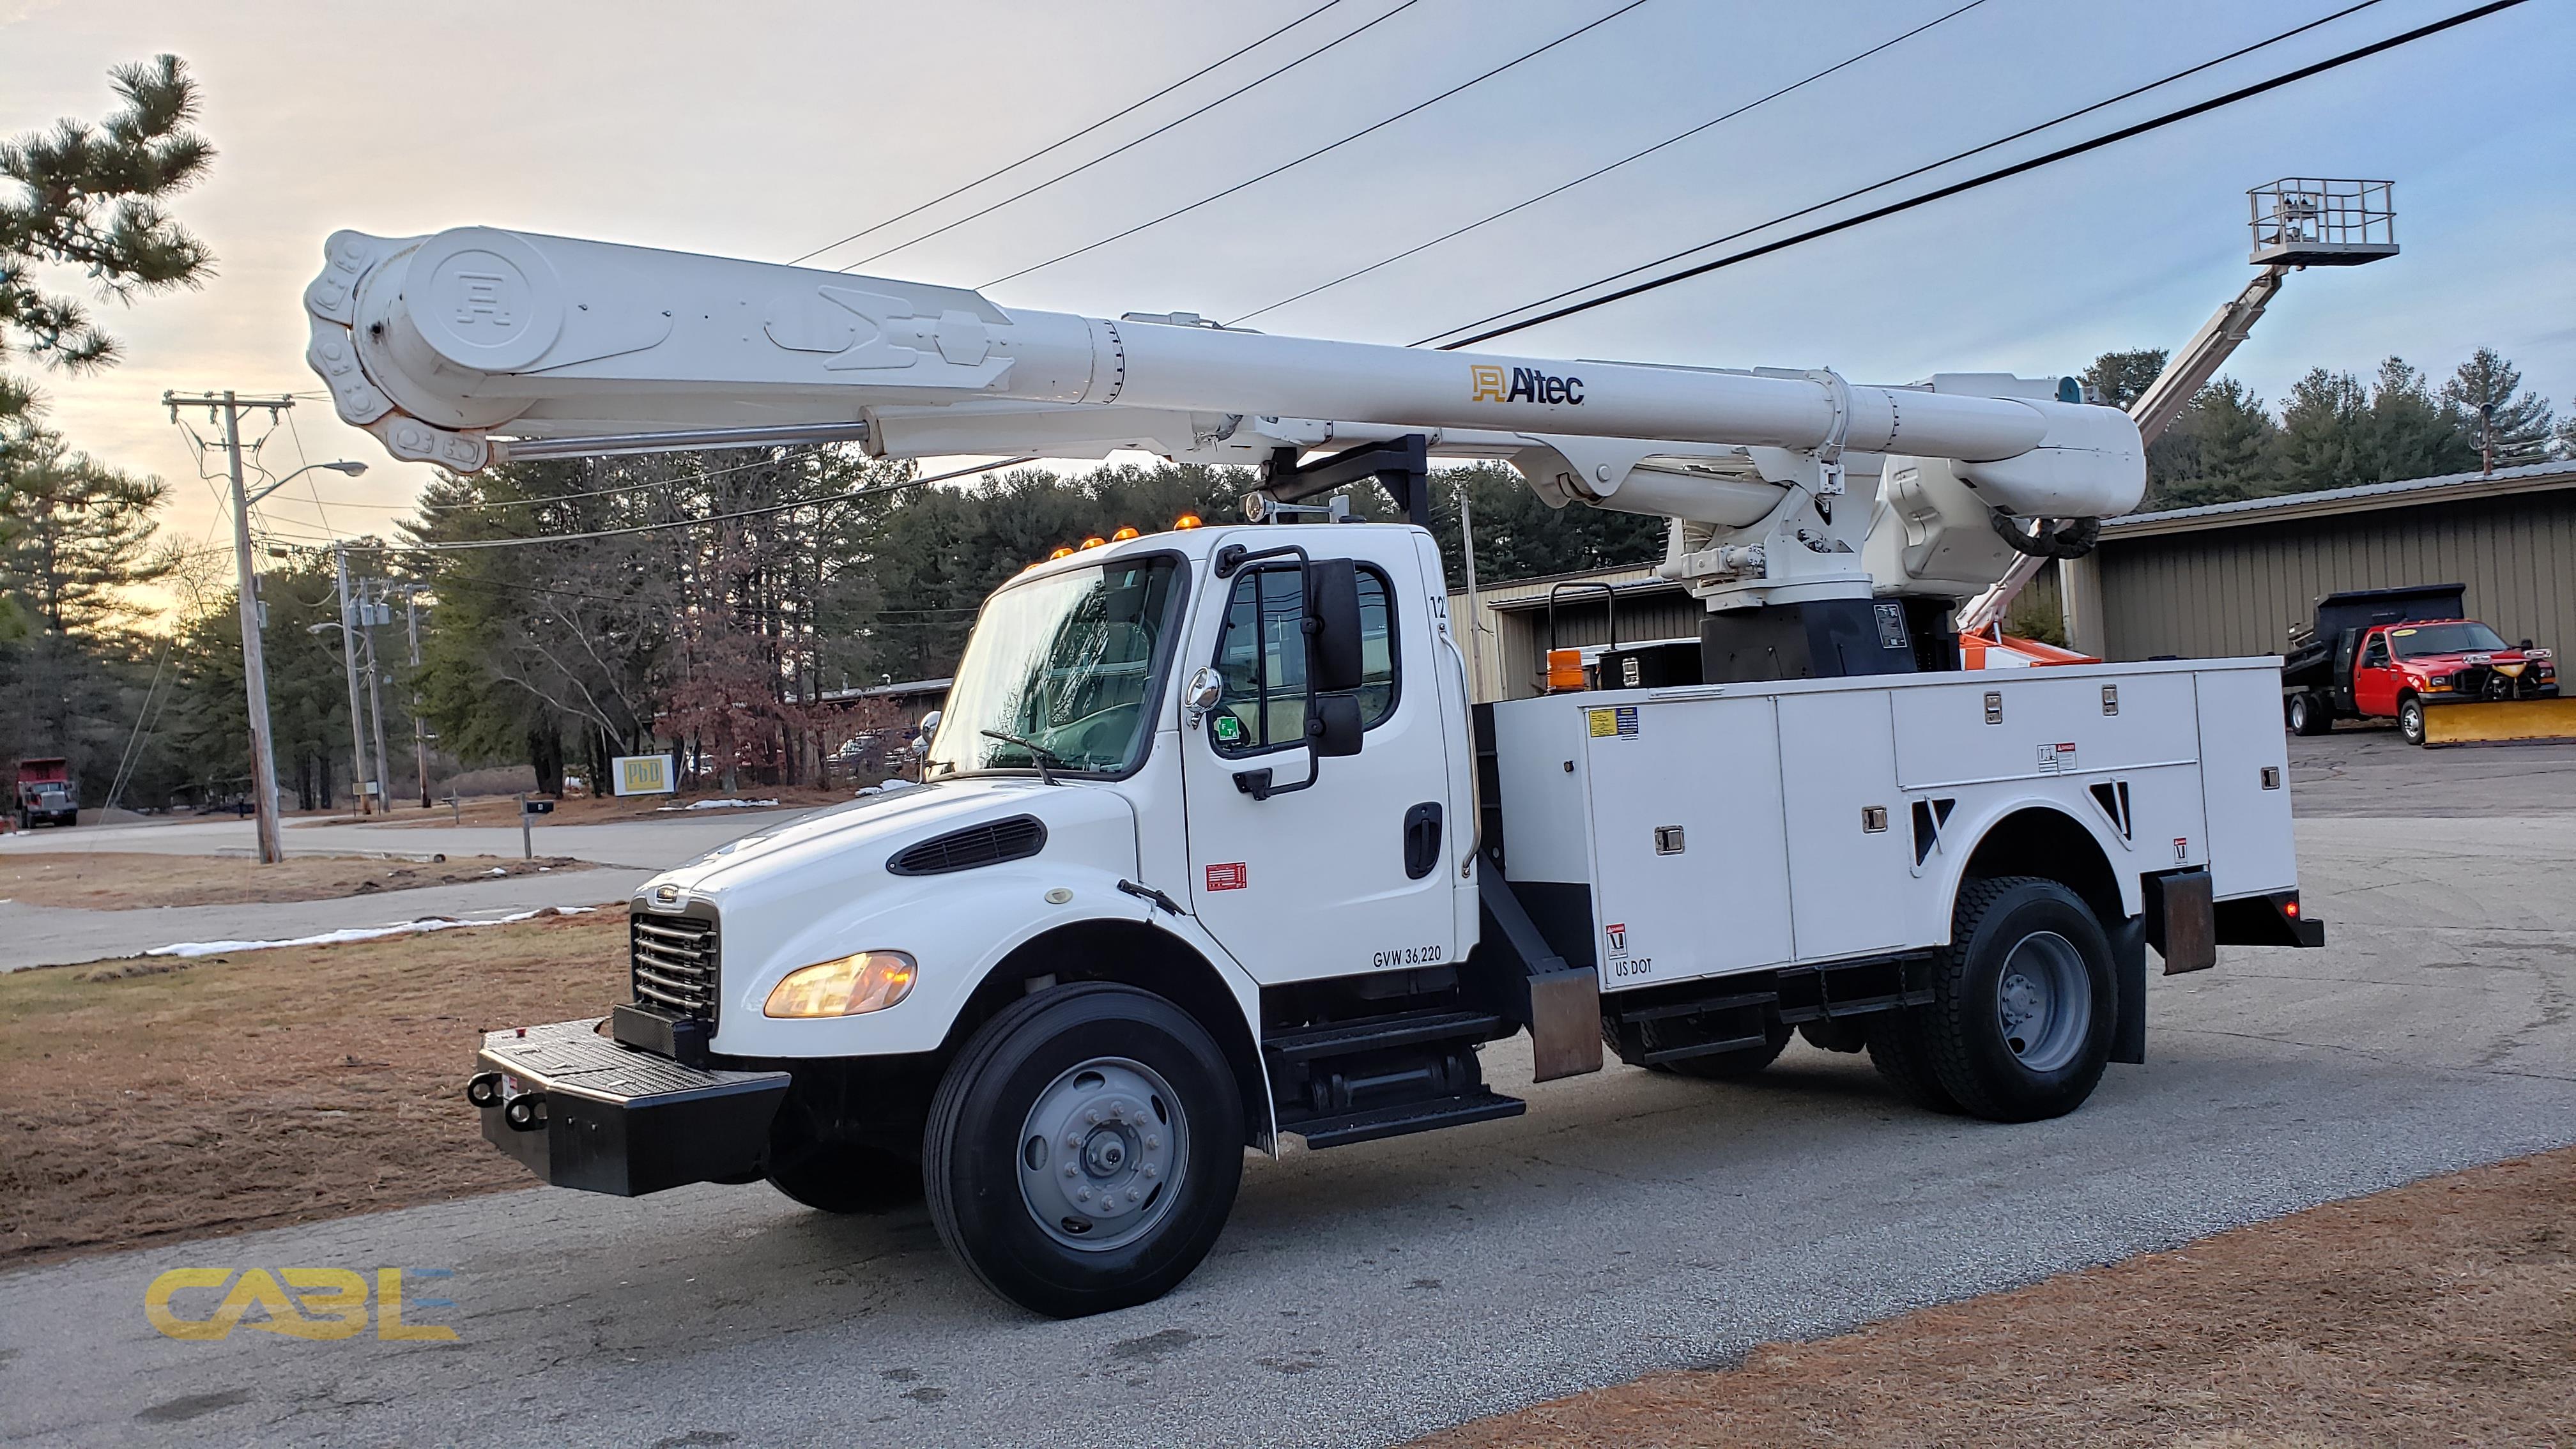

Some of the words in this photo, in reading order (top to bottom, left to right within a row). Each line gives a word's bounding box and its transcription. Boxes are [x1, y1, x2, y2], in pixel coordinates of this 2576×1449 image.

[1506, 367, 1584, 405] Altec
[628, 762, 660, 784] PbD
[1373, 949, 1402, 968] GVW
[1405, 945, 1441, 965] 36,220
[1615, 960, 1629, 977] US
[1630, 958, 1652, 975] DOT
